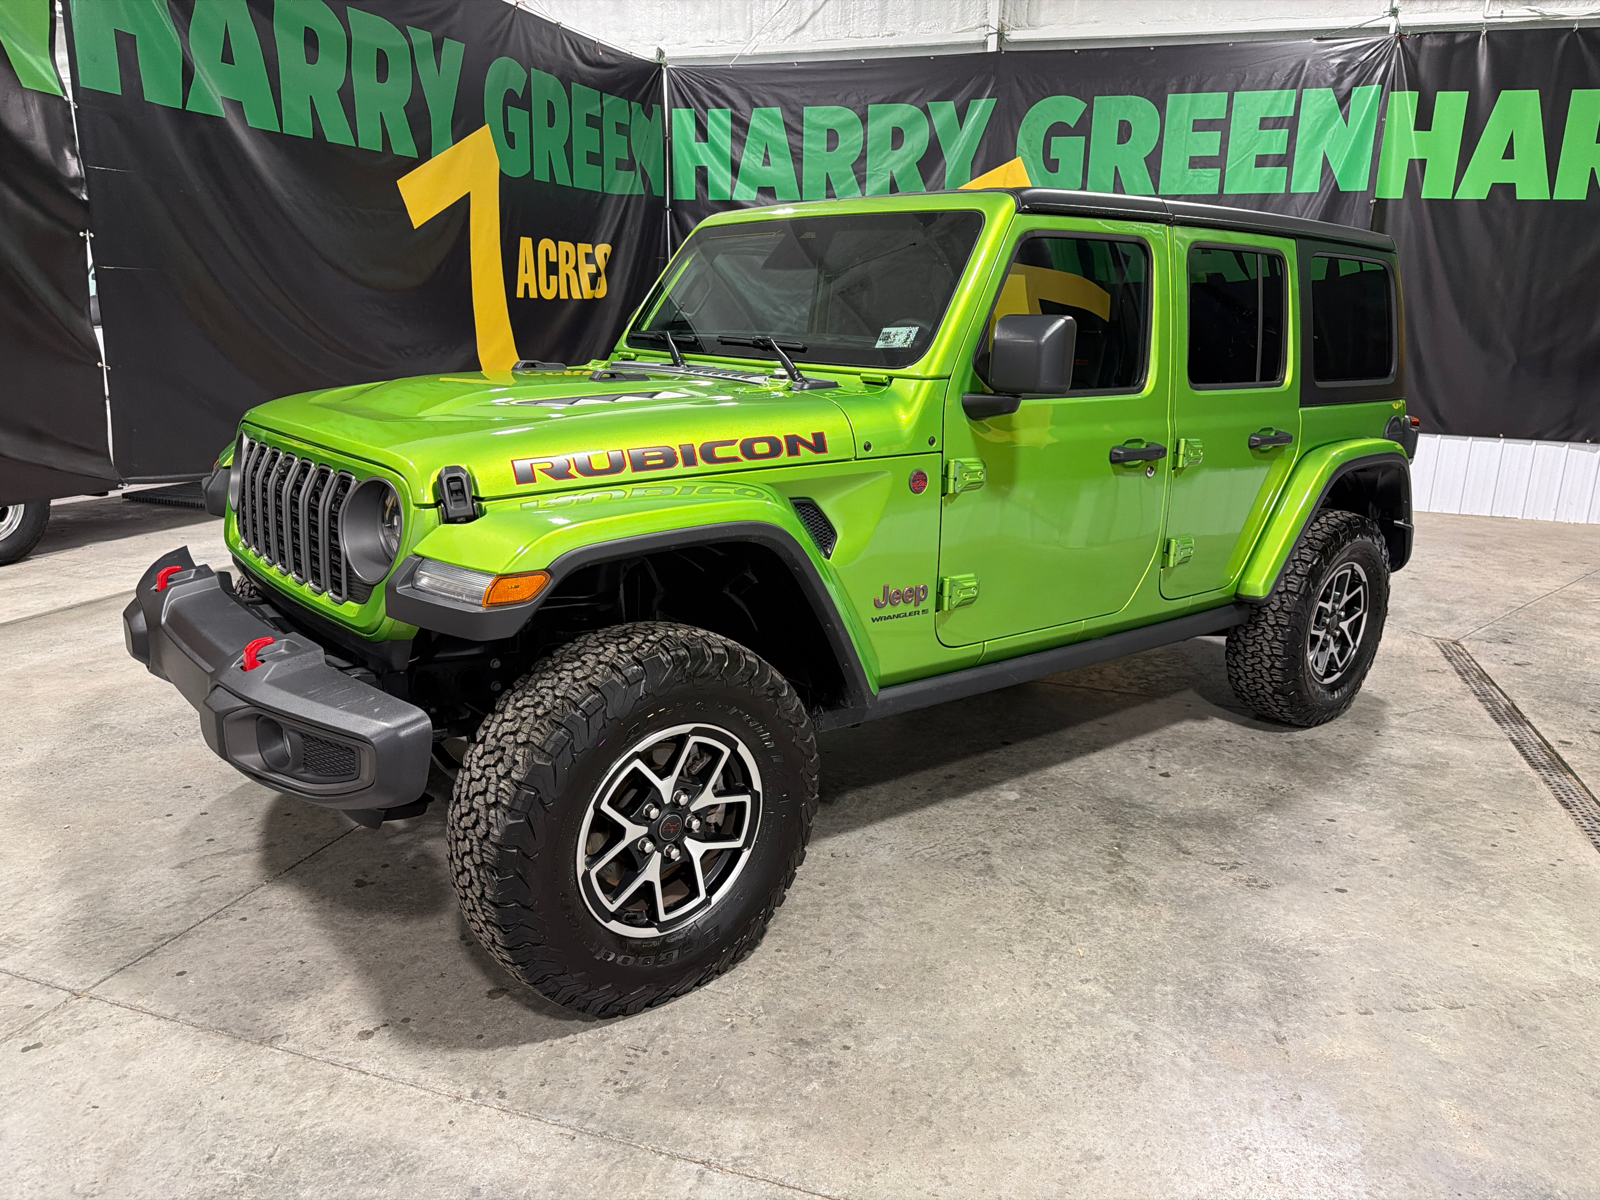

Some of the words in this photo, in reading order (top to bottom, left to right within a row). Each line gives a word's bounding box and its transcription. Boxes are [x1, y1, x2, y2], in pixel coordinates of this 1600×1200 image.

[70, 0, 465, 158] HARRY
[484, 56, 665, 197] GREEN
[672, 98, 997, 200] HARRY
[1016, 85, 1382, 196] GREEN
[516, 236, 612, 300] ACRES
[511, 431, 829, 486] RUBICON
[870, 609, 921, 624] WRANGLER
[873, 583, 929, 609] Jeep
